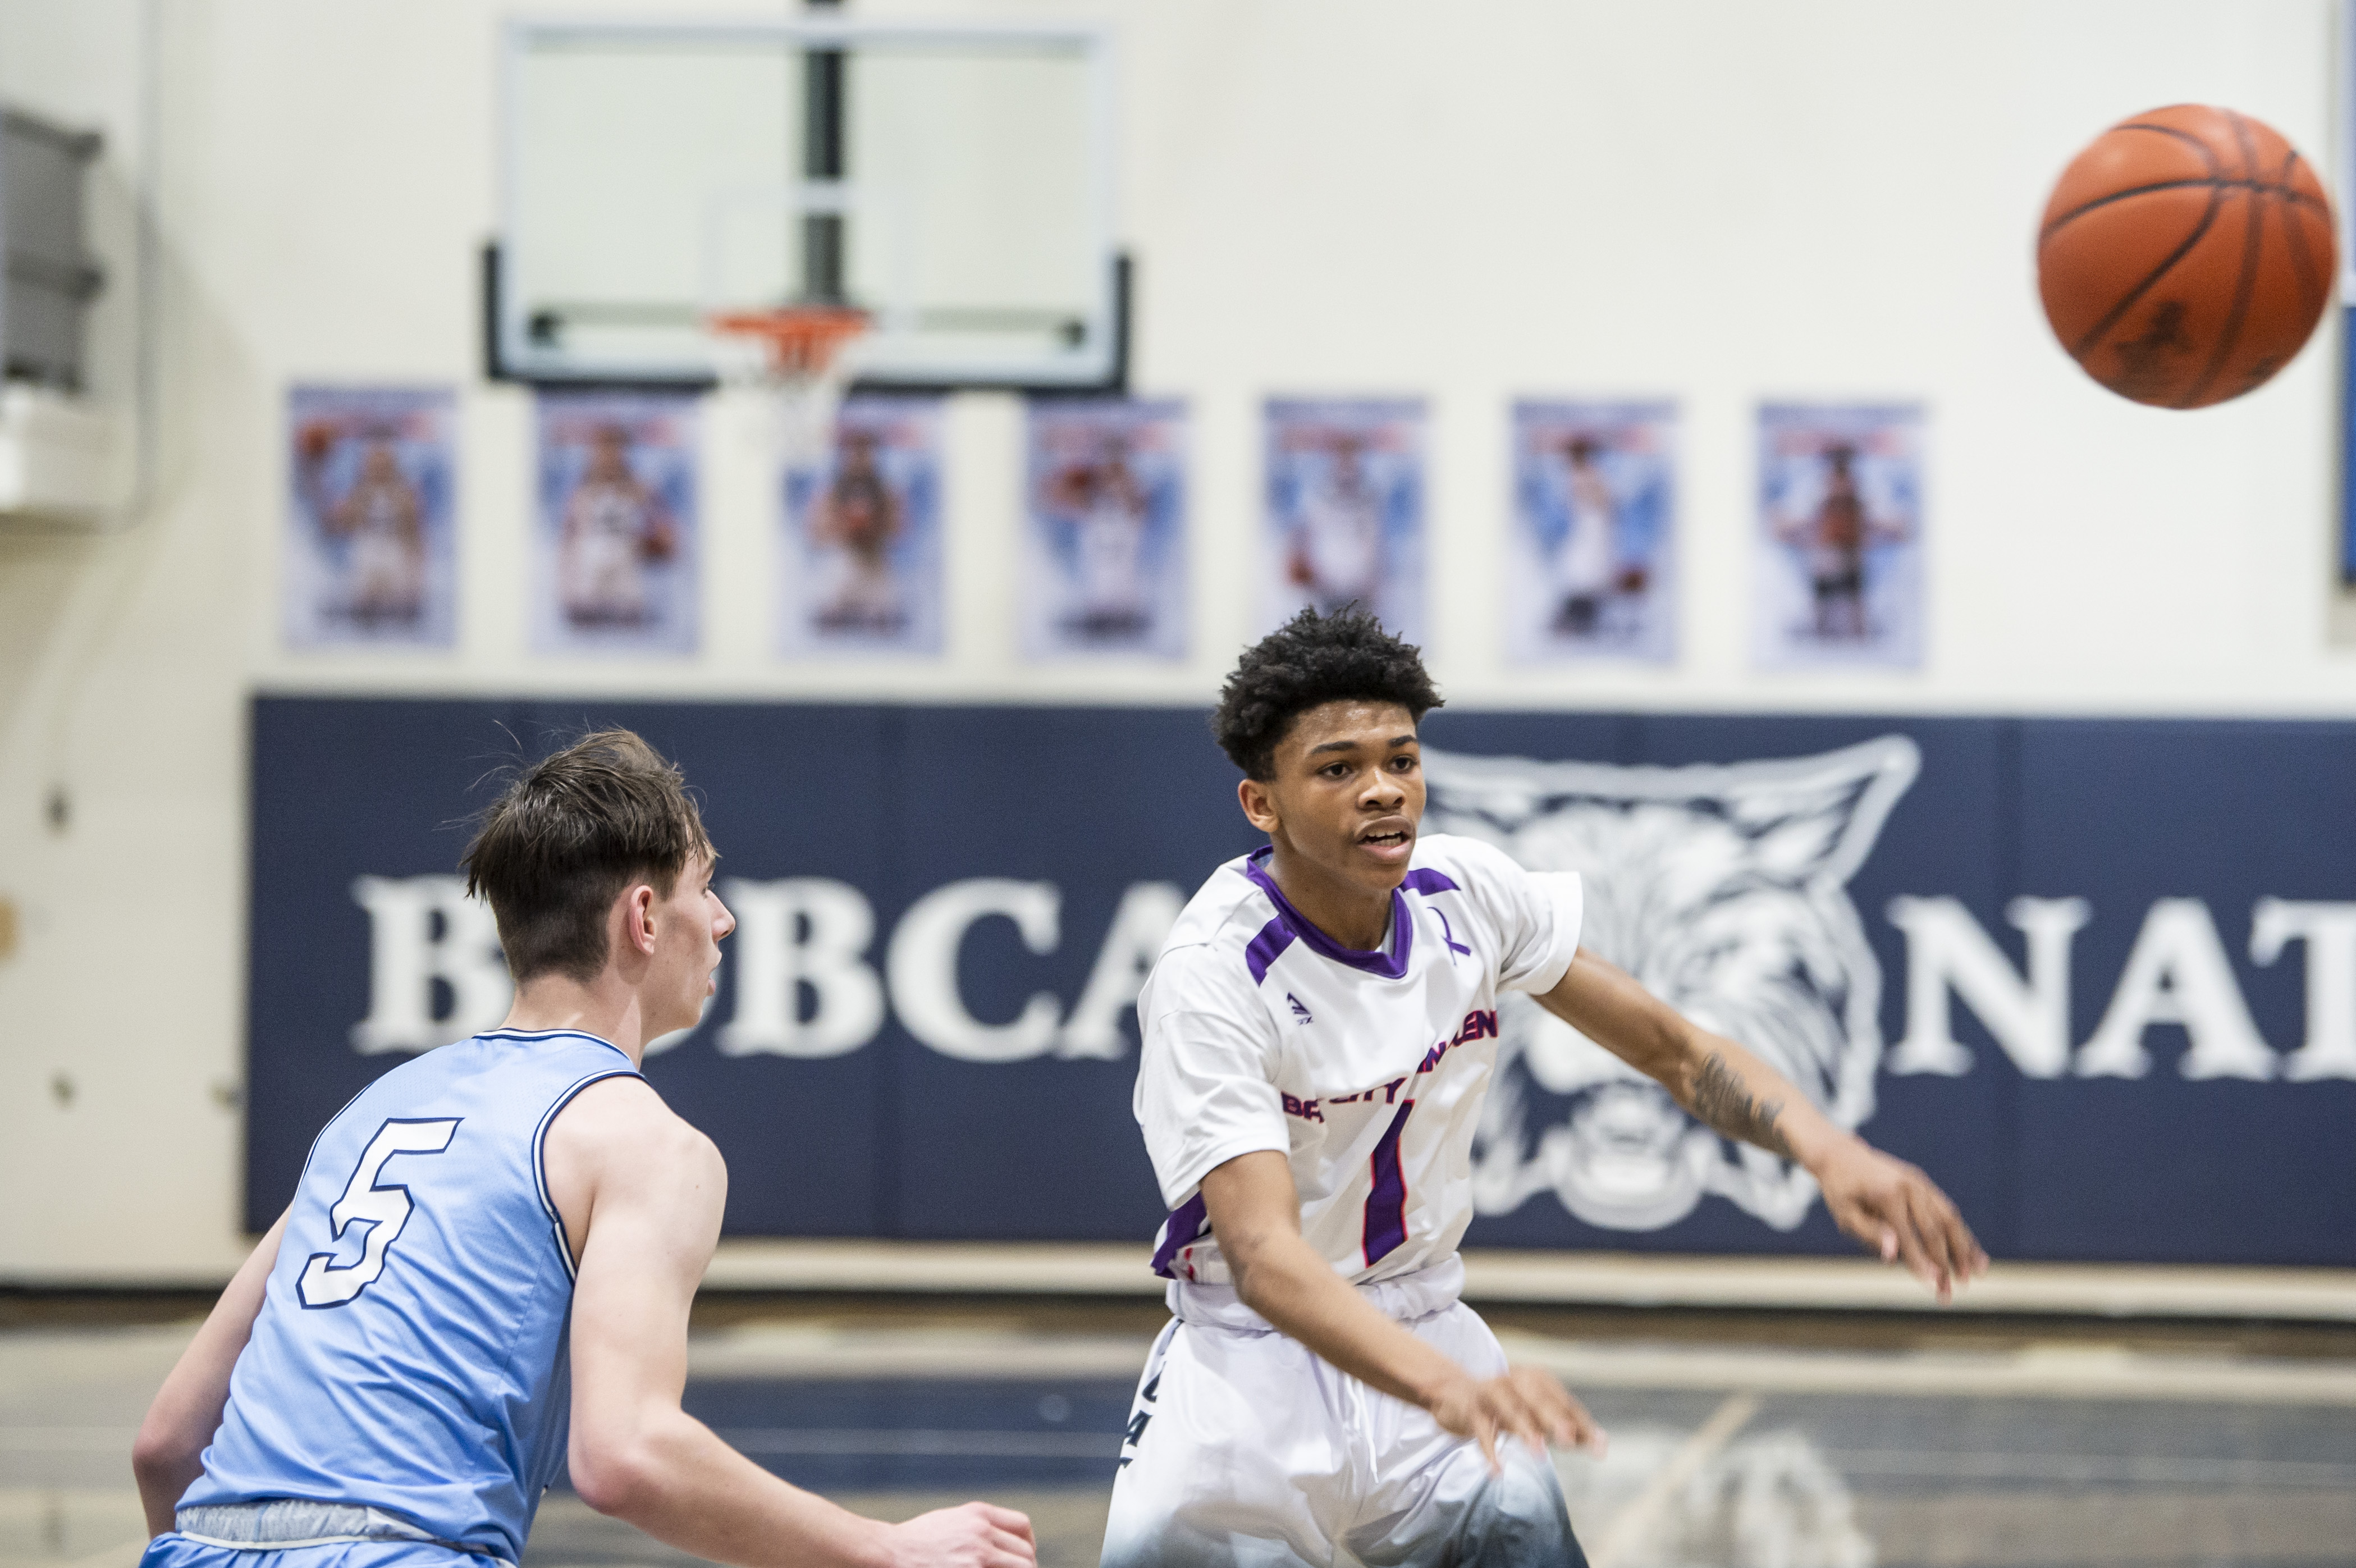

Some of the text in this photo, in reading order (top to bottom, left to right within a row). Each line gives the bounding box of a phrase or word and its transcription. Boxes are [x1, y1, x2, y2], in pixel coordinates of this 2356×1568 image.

[350, 875, 1186, 1061] BBCA
[295, 1117, 465, 1310] 5
[1362, 1099, 1415, 1269] 1
